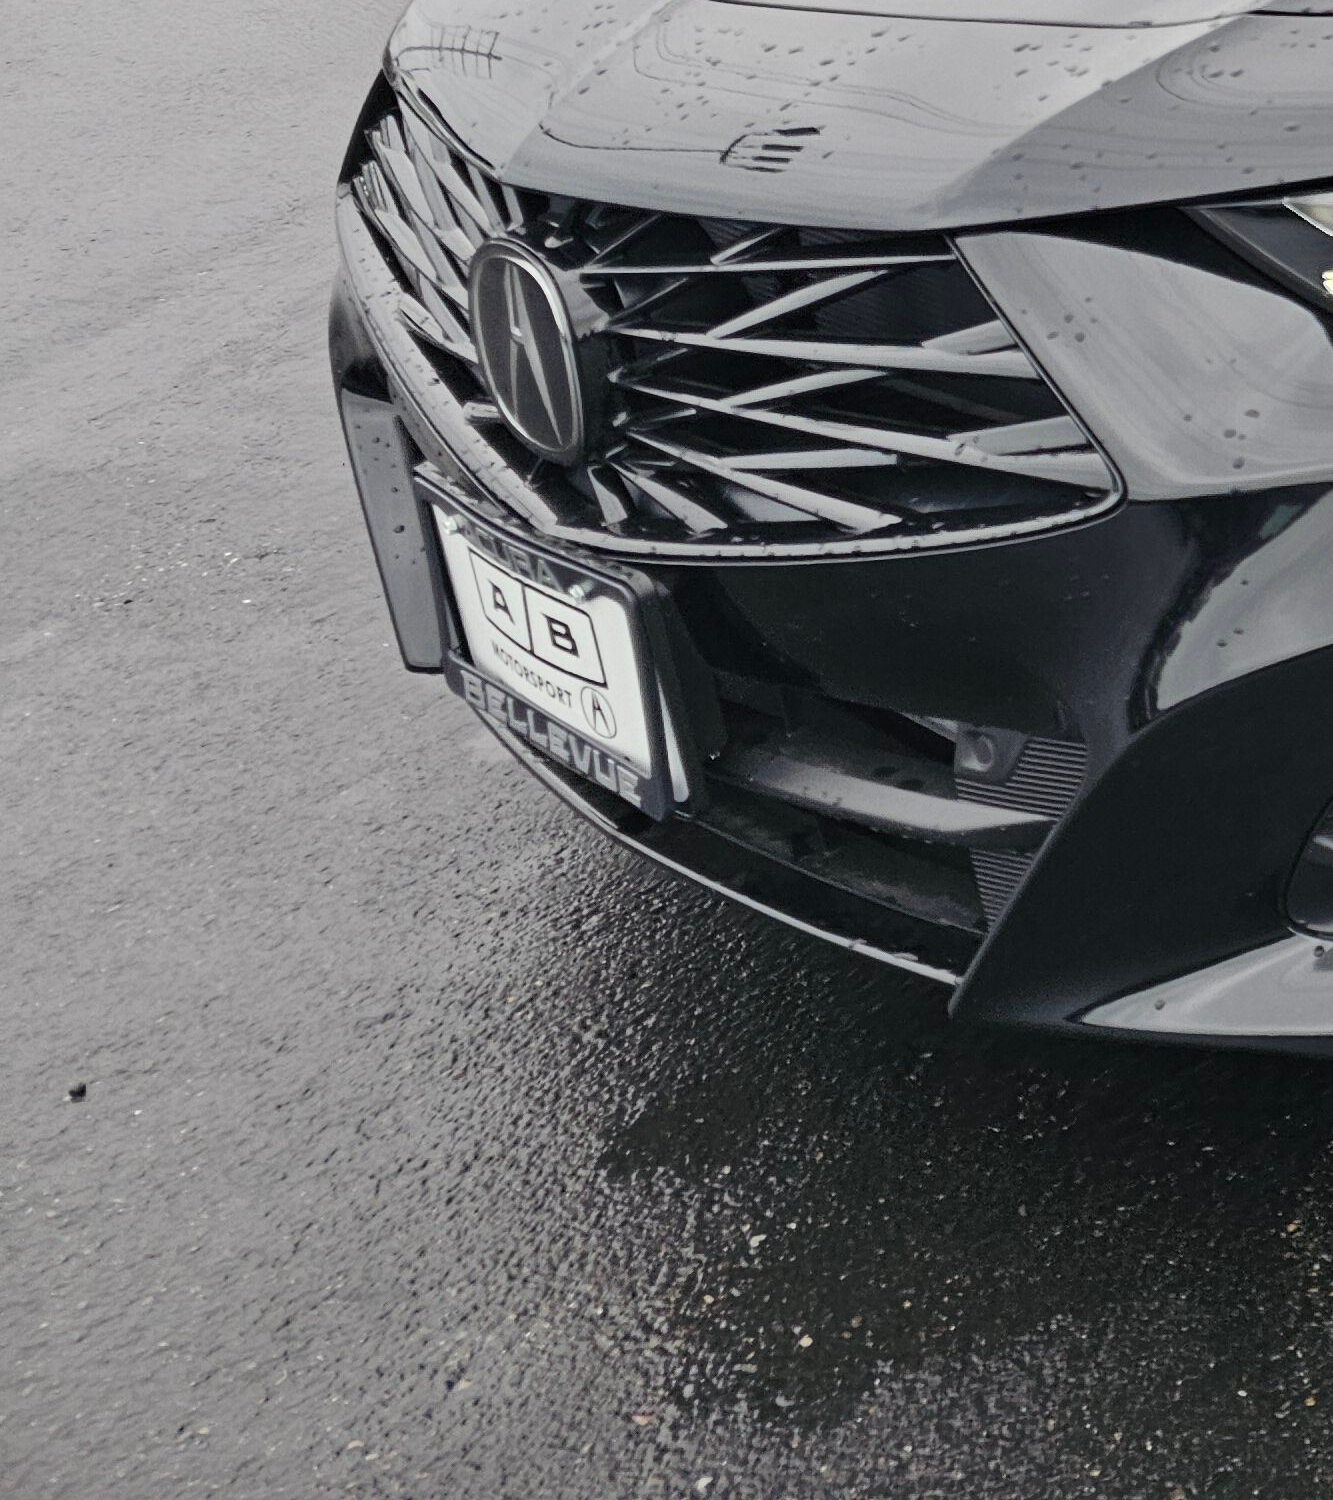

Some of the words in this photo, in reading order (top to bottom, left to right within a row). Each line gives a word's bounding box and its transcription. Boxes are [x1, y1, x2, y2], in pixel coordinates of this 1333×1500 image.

[488, 579, 515, 625] A
[541, 612, 580, 658] B
[491, 639, 573, 709] MOTORSPORT
[460, 669, 642, 809] BELLEVUE
